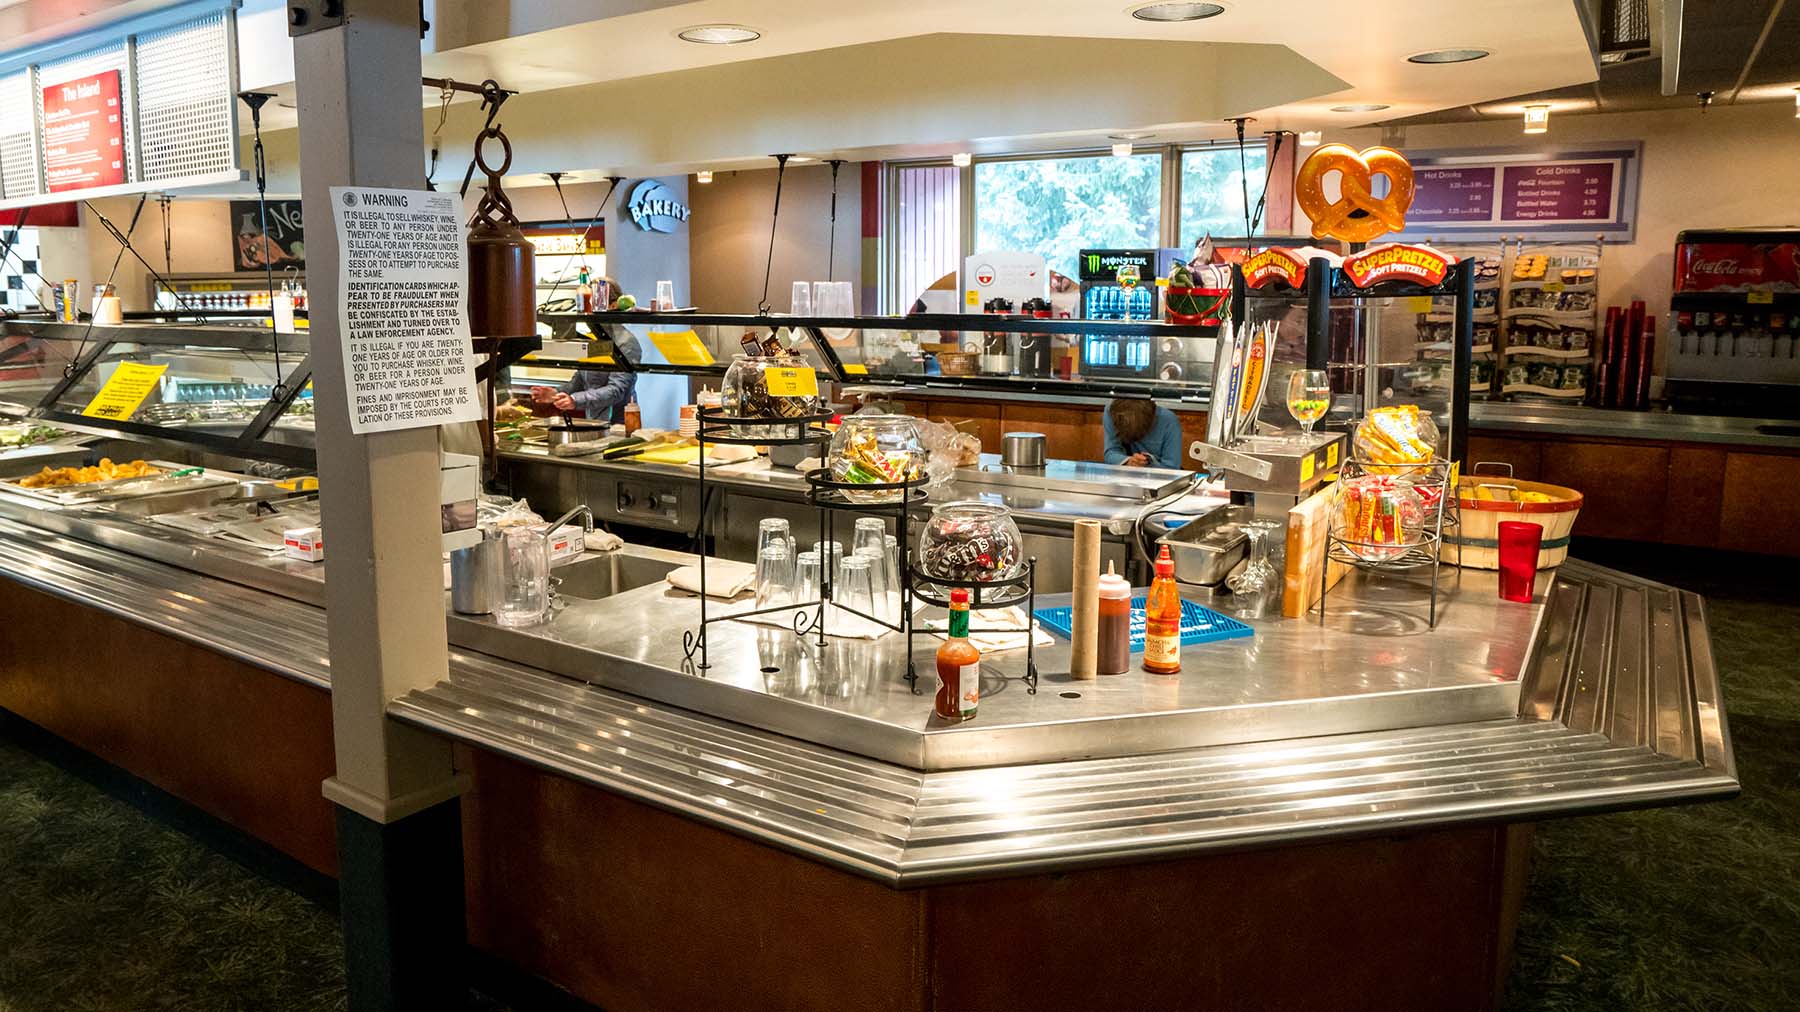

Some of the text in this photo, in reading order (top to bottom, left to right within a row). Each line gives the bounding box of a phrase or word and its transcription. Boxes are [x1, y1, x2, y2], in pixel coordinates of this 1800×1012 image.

[62, 80, 100, 102] The Island
[1536, 167, 1581, 176] Cold Drinks
[362, 194, 408, 207] WARNING
[344, 211, 350, 219] IT
[358, 212, 386, 221] ILLEGAL
[387, 213, 395, 221] TO
[395, 213, 411, 222] SELL
[631, 200, 691, 223] BAKERY
[345, 221, 458, 232] OR BEER TO ANY PERSON UNDER
[347, 231, 390, 240] TWENTY-ONE
[393, 232, 414, 240] YEARS
[415, 233, 423, 241] OF
[425, 233, 437, 241] AGE
[348, 240, 458, 251] IS ILLEGAL FOR ANY PERSON UNDER
[350, 250, 391, 259] TWENTY-ONE
[393, 251, 413, 259] YEARS
[423, 252, 435, 260] AGE
[437, 252, 444, 260] TO
[349, 260, 366, 268] SESS
[368, 260, 378, 268] OR
[379, 260, 387, 268] TO
[389, 260, 417, 268] ATTEMPT
[428, 261, 459, 269] PURCHASE
[1101, 257, 1147, 266] MONSTER
[364, 270, 384, 278] SAME.
[1369, 263, 1428, 278] SOFT PRETZELS
[348, 282, 404, 290] IDENTIFICATION
[405, 282, 426, 290] CARDS
[427, 282, 448, 290] WHICH
[348, 292, 367, 300] PEAR
[394, 291, 438, 299] FRAUDULENT
[348, 300, 458, 309] PRESENTED BY PURCHASERS MAY
[349, 311, 357, 319] BE
[360, 311, 408, 319] CONFISCATED
[437, 309, 459, 317] ESTAB-
[349, 320, 385, 329] LISHMENT
[387, 320, 401, 328] AND
[404, 319, 430, 327] TURNED
[452, 318, 460, 326] TO
[350, 328, 455, 339] A LAW ENFORCEMENT AGENCY.
[351, 344, 357, 352] IT
[370, 342, 395, 351] ILLEGAL
[406, 341, 419, 349] YOU
[437, 339, 463, 348] TWENTY-
[352, 353, 367, 361] ONE
[369, 352, 390, 361] YEARS
[391, 351, 400, 359] OF
[402, 351, 415, 359] AGE
[417, 350, 426, 358] OR
[429, 349, 450, 358] OLDER
[352, 363, 368, 372] YOU
[382, 360, 414, 370] PURCHASE
[354, 367, 465, 382] OR BEER FOR A PERSON UNDER
[356, 381, 396, 391] TWENTY-ONE
[399, 379, 419, 387] YEARS
[420, 378, 429, 386] OF
[357, 395, 376, 404] FINES
[379, 394, 392, 402] AND
[395, 390, 440, 400] IMPRISONMENT
[443, 388, 456, 396] MAY
[358, 404, 387, 414] IMPOSED
[390, 403, 399, 411] BY
[400, 402, 412, 410] THE
[414, 399, 439, 408] COURTS
[441, 398, 453, 406] FOR
[358, 408, 453, 424] LATION OF THESE PROVISIONS.
